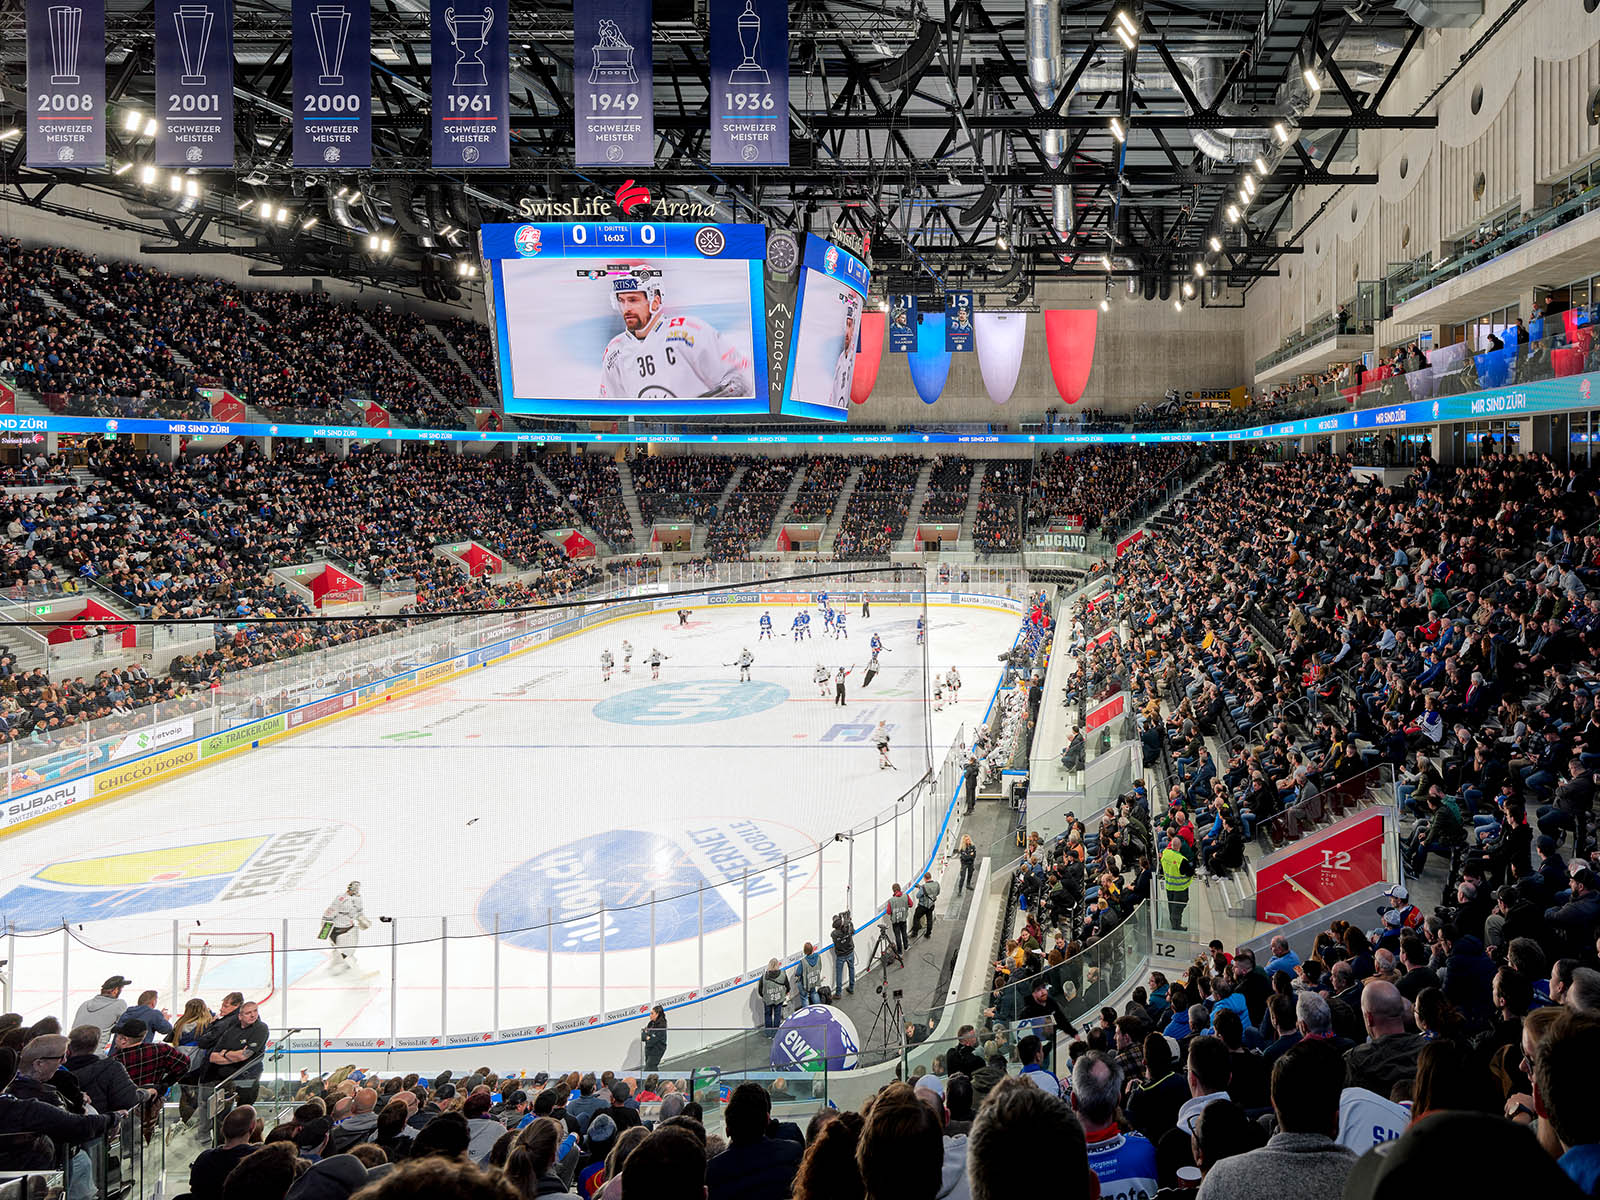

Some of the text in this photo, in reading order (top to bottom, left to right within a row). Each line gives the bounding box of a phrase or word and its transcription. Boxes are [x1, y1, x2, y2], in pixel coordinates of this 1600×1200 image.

[38, 95, 93, 111] 2008
[169, 95, 219, 112] 2001
[303, 95, 360, 112] 2000
[448, 95, 491, 112] 1961
[590, 94, 639, 111] 1949
[725, 94, 774, 110] 1936
[39, 125, 92, 133] SCHWEIZER
[168, 125, 221, 133] SCHWEIZER
[305, 125, 359, 133] SCHWEIZER
[444, 125, 497, 133] SCHWEIZER
[588, 124, 641, 133] SCHWEIZER
[723, 124, 776, 132] SCHWEIZER
[47, 134, 85, 142] MEISTER
[176, 134, 213, 142] MEISTER
[312, 134, 351, 142] MEISTER
[452, 134, 489, 143] MEISTER
[596, 133, 634, 142] MEISTER
[731, 132, 769, 141] MEISTER
[519, 197, 718, 217] SwissLife Arena
[572, 225, 587, 244] 0
[603, 234, 625, 242] 16:03
[640, 225, 656, 244] 0
[951, 294, 970, 308] 15
[666, 347, 676, 365] C
[771, 319, 786, 392] NORQAIN
[637, 355, 656, 378] 36
[1472, 393, 1526, 414] MIR SIND ZÜRI
[1376, 407, 1406, 424] MIR SIND ZÜRI
[19, 418, 47, 429] ZÜRI
[169, 424, 186, 432] MIR
[210, 424, 230, 434] ZÜRI
[327, 429, 342, 437] SIND
[343, 429, 357, 437] ZÜRI
[1035, 534, 1086, 549] LUGANO
[225, 718, 280, 745] TRACKER.COM
[99, 766, 152, 791] CHICCO
[156, 751, 194, 772] D'ORO
[9, 785, 76, 816] SUBARU
[687, 828, 777, 898] INTERNET
[706, 982, 732, 994] SwissLife
[608, 1009, 637, 1021] SwissLife
[555, 1020, 586, 1031] SwissLife
[449, 1036, 480, 1044] SwissLife
[502, 1029, 533, 1039] SwissLife
